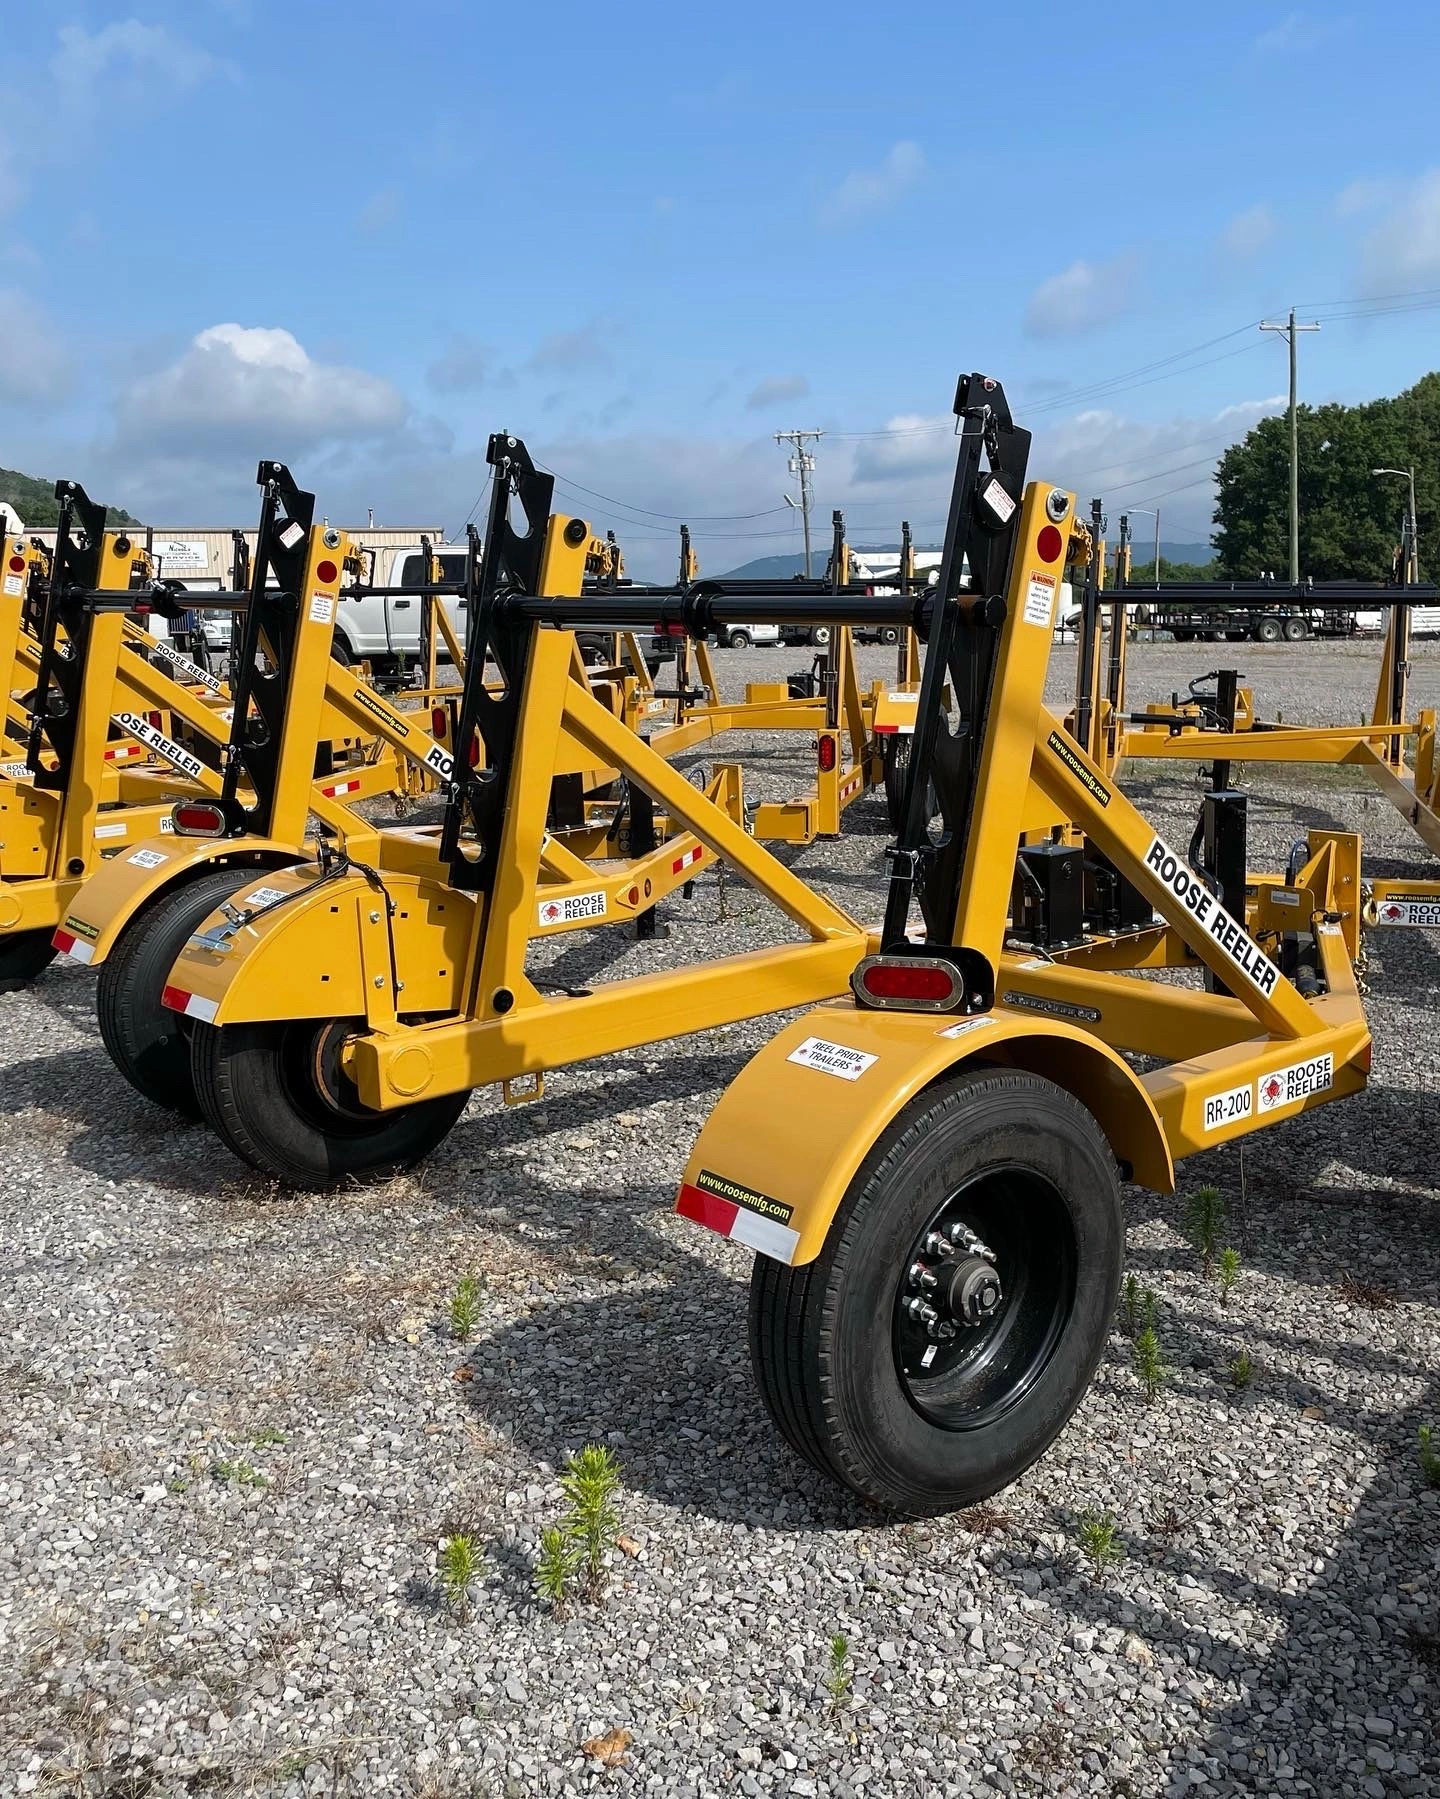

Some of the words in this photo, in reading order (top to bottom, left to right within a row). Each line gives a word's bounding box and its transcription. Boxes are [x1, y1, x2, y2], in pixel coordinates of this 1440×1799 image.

[156, 643, 186, 667] ROOSE
[186, 663, 220, 689] REELER
[355, 691, 408, 735] www.roosemfg.com
[112, 713, 150, 737] OSE
[150, 733, 202, 776] REELER
[6, 763, 26, 771] ROO
[1050, 734, 1109, 804] www.roosemfg.com
[564, 893, 604, 910] ROOSE
[564, 903, 605, 920] REELER
[1409, 904, 1440, 915] ROO
[1146, 840, 1213, 923] ROOSE
[1210, 910, 1277, 995] REELER
[1408, 914, 1440, 924] REEL
[808, 1050, 853, 1070] TRAILERS
[812, 1041, 836, 1054] REEL
[835, 1048, 866, 1063] PRIDE
[1287, 1057, 1331, 1085] ROOSE
[1287, 1072, 1331, 1100] REELER
[1206, 1090, 1251, 1125] RR-200
[699, 1173, 790, 1220] www.roosemfg.com
